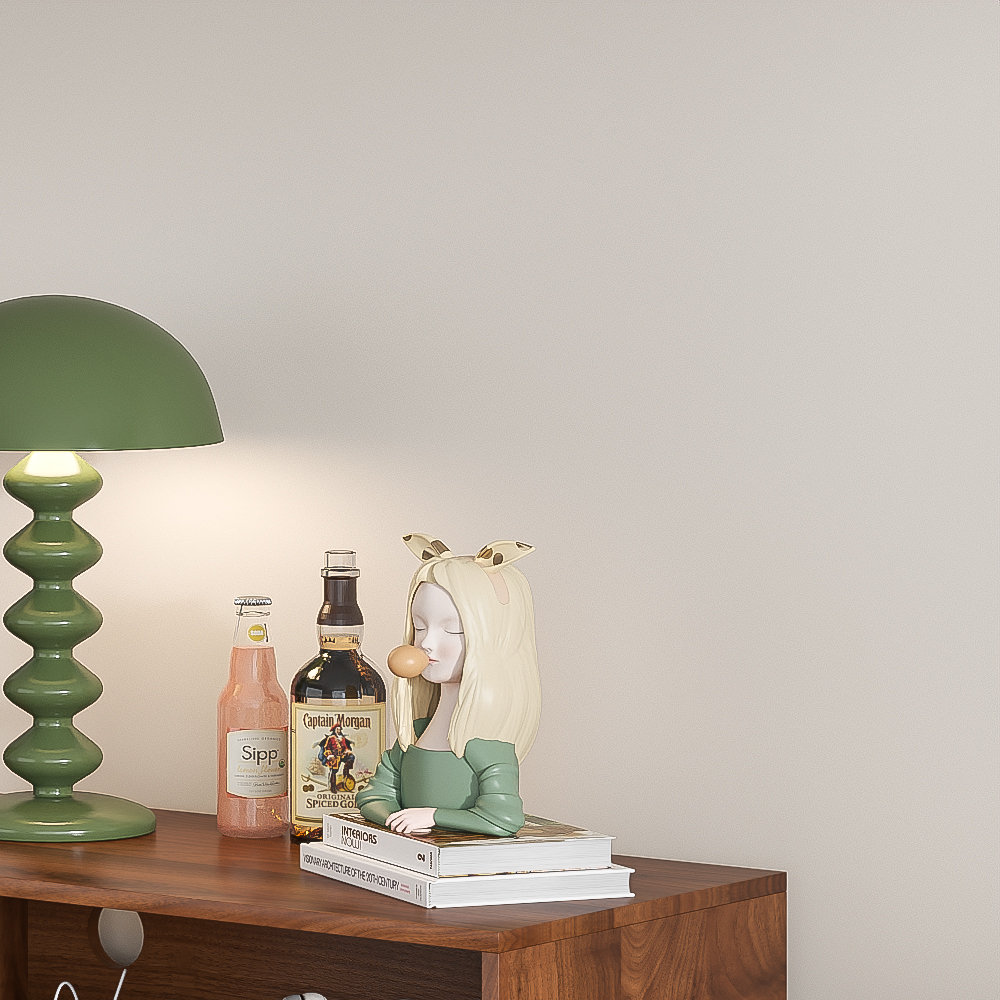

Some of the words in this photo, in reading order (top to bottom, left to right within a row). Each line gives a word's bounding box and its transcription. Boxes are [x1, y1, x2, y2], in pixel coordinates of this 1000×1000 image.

[303, 713, 334, 729] Captain
[336, 713, 371, 729] Morgan
[242, 745, 278, 766] Sipp
[305, 798, 339, 809] SPICED
[341, 825, 378, 845] INTERIORS
[417, 853, 426, 862] 2
[322, 859, 351, 877] ARCHITECTURE
